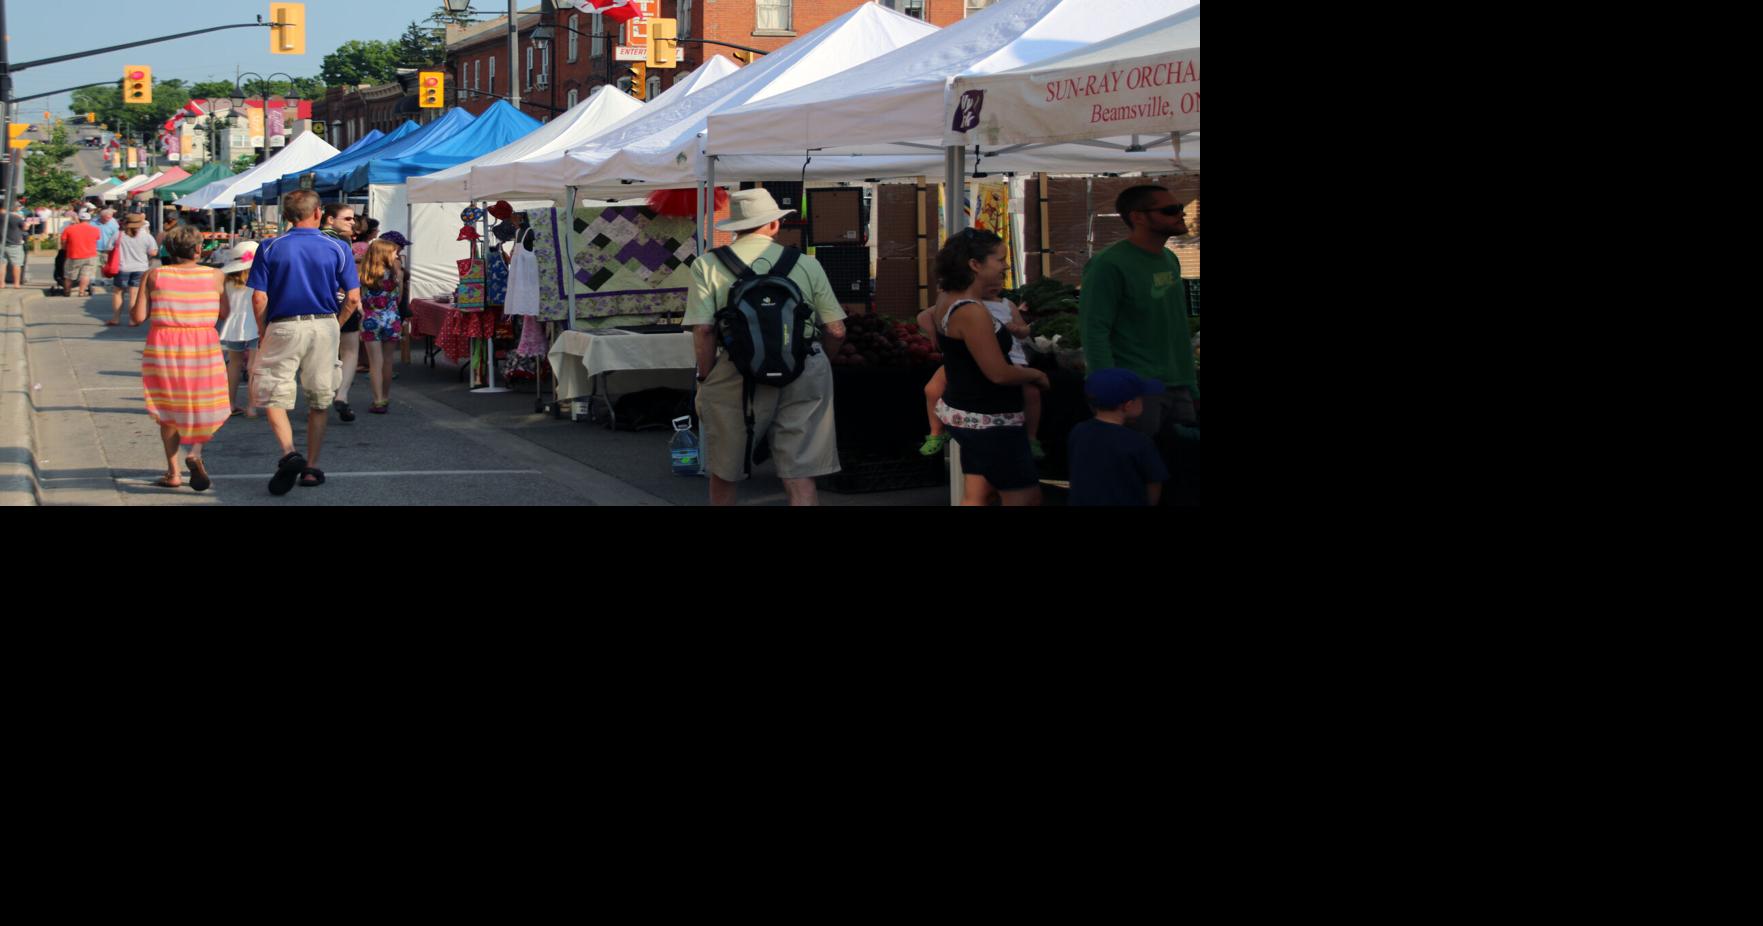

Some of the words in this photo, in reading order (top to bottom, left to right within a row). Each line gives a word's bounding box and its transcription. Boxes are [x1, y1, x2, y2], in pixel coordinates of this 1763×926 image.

[1045, 69, 1124, 103] SUN-RAY
[1126, 59, 1200, 90] ORCHA
[1090, 95, 1174, 123] Beamsville,
